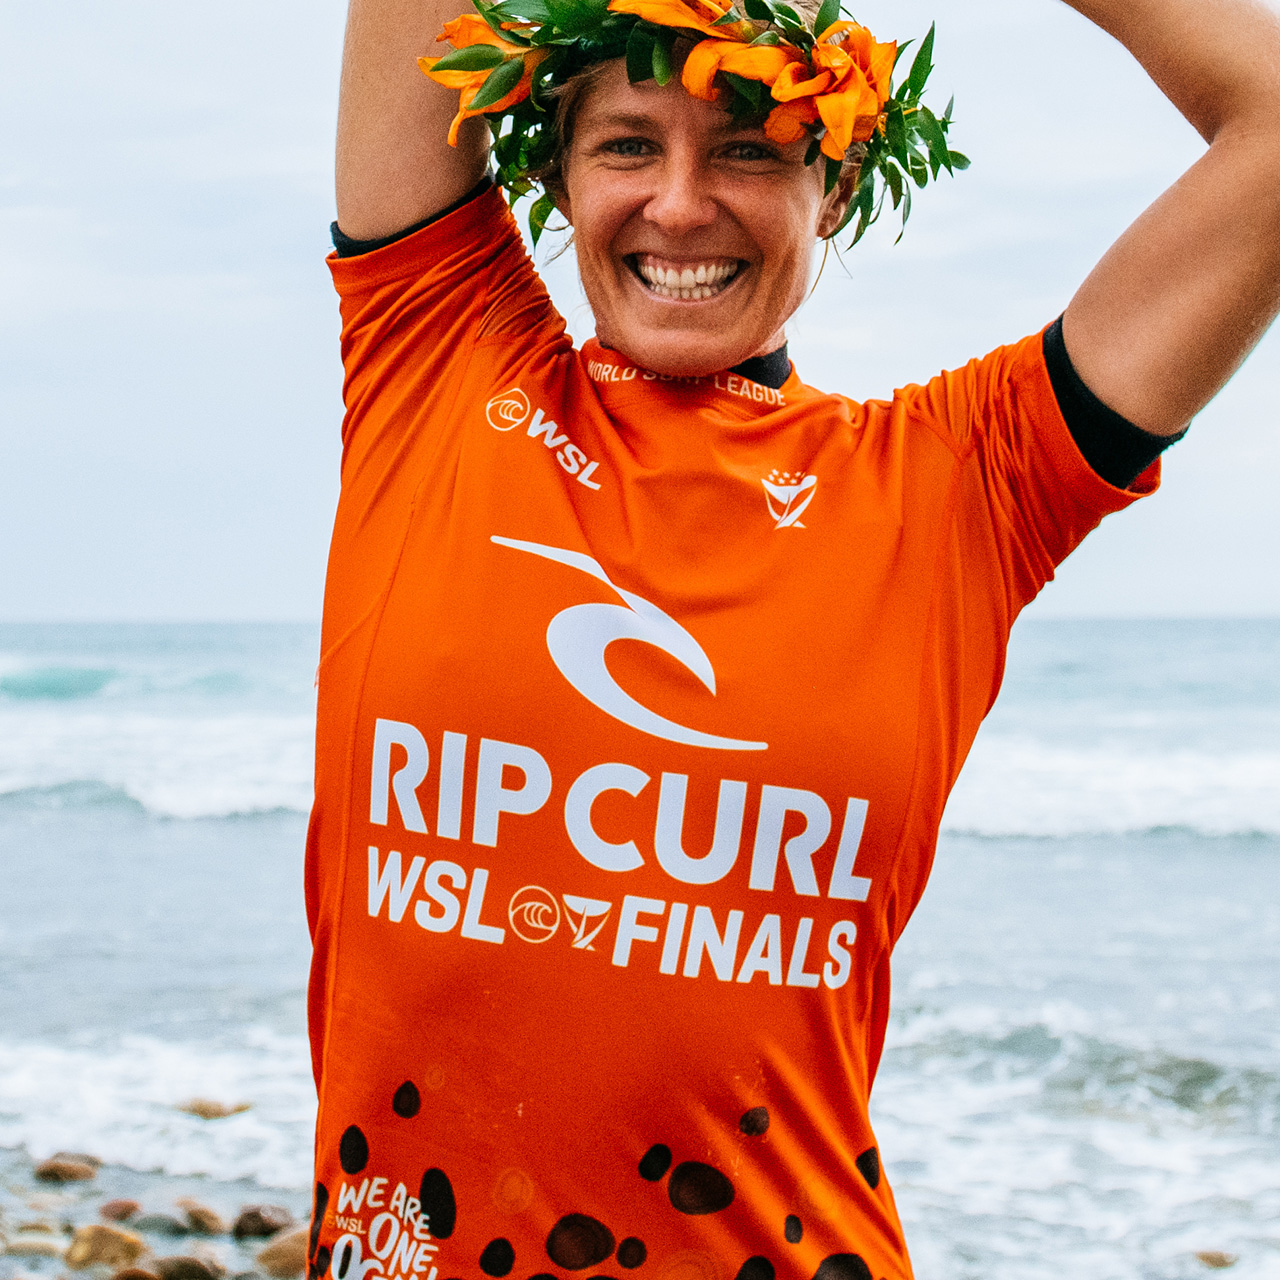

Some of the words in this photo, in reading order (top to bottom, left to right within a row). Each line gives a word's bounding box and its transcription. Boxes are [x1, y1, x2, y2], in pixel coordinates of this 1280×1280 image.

[587, 360, 638, 382] WORLD
[714, 374, 787, 406] LEAGUE
[526, 407, 602, 491] WSL
[369, 718, 552, 848] RIP
[564, 762, 873, 903] CURL
[367, 846, 505, 945] WSL
[611, 894, 857, 990] FINALS
[335, 1214, 367, 1235] WSL
[337, 1176, 389, 1214] WE
[389, 1182, 432, 1241] ARE
[368, 1211, 439, 1277] ONE
